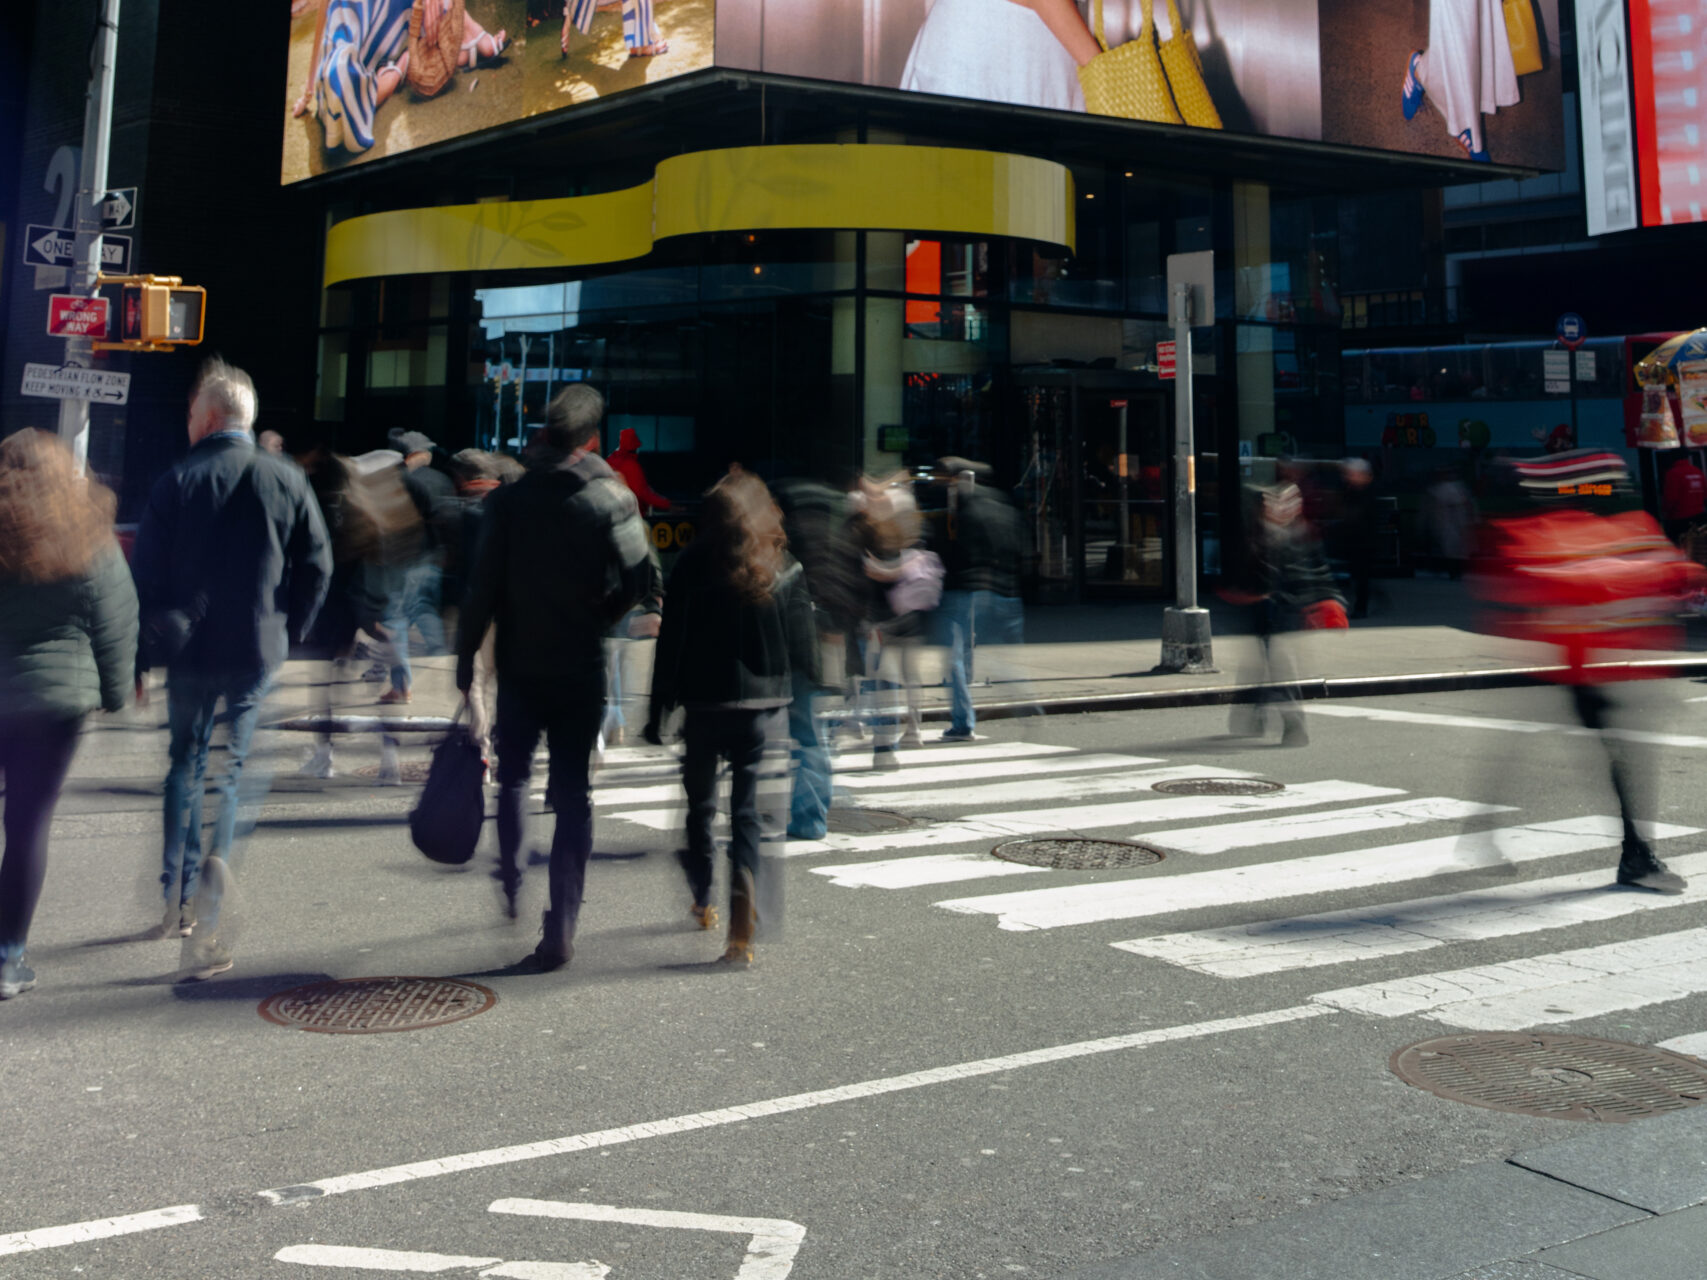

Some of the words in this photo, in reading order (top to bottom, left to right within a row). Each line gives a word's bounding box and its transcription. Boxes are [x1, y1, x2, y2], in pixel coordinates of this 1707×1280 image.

[43, 239, 73, 257] ONE
[60, 309, 98, 323] WRONG
[65, 322, 90, 334] WAY
[81, 372, 103, 384] FLOW
[105, 376, 128, 387] ZONE
[25, 381, 46, 393] KEEP
[48, 384, 81, 396] MOVING
